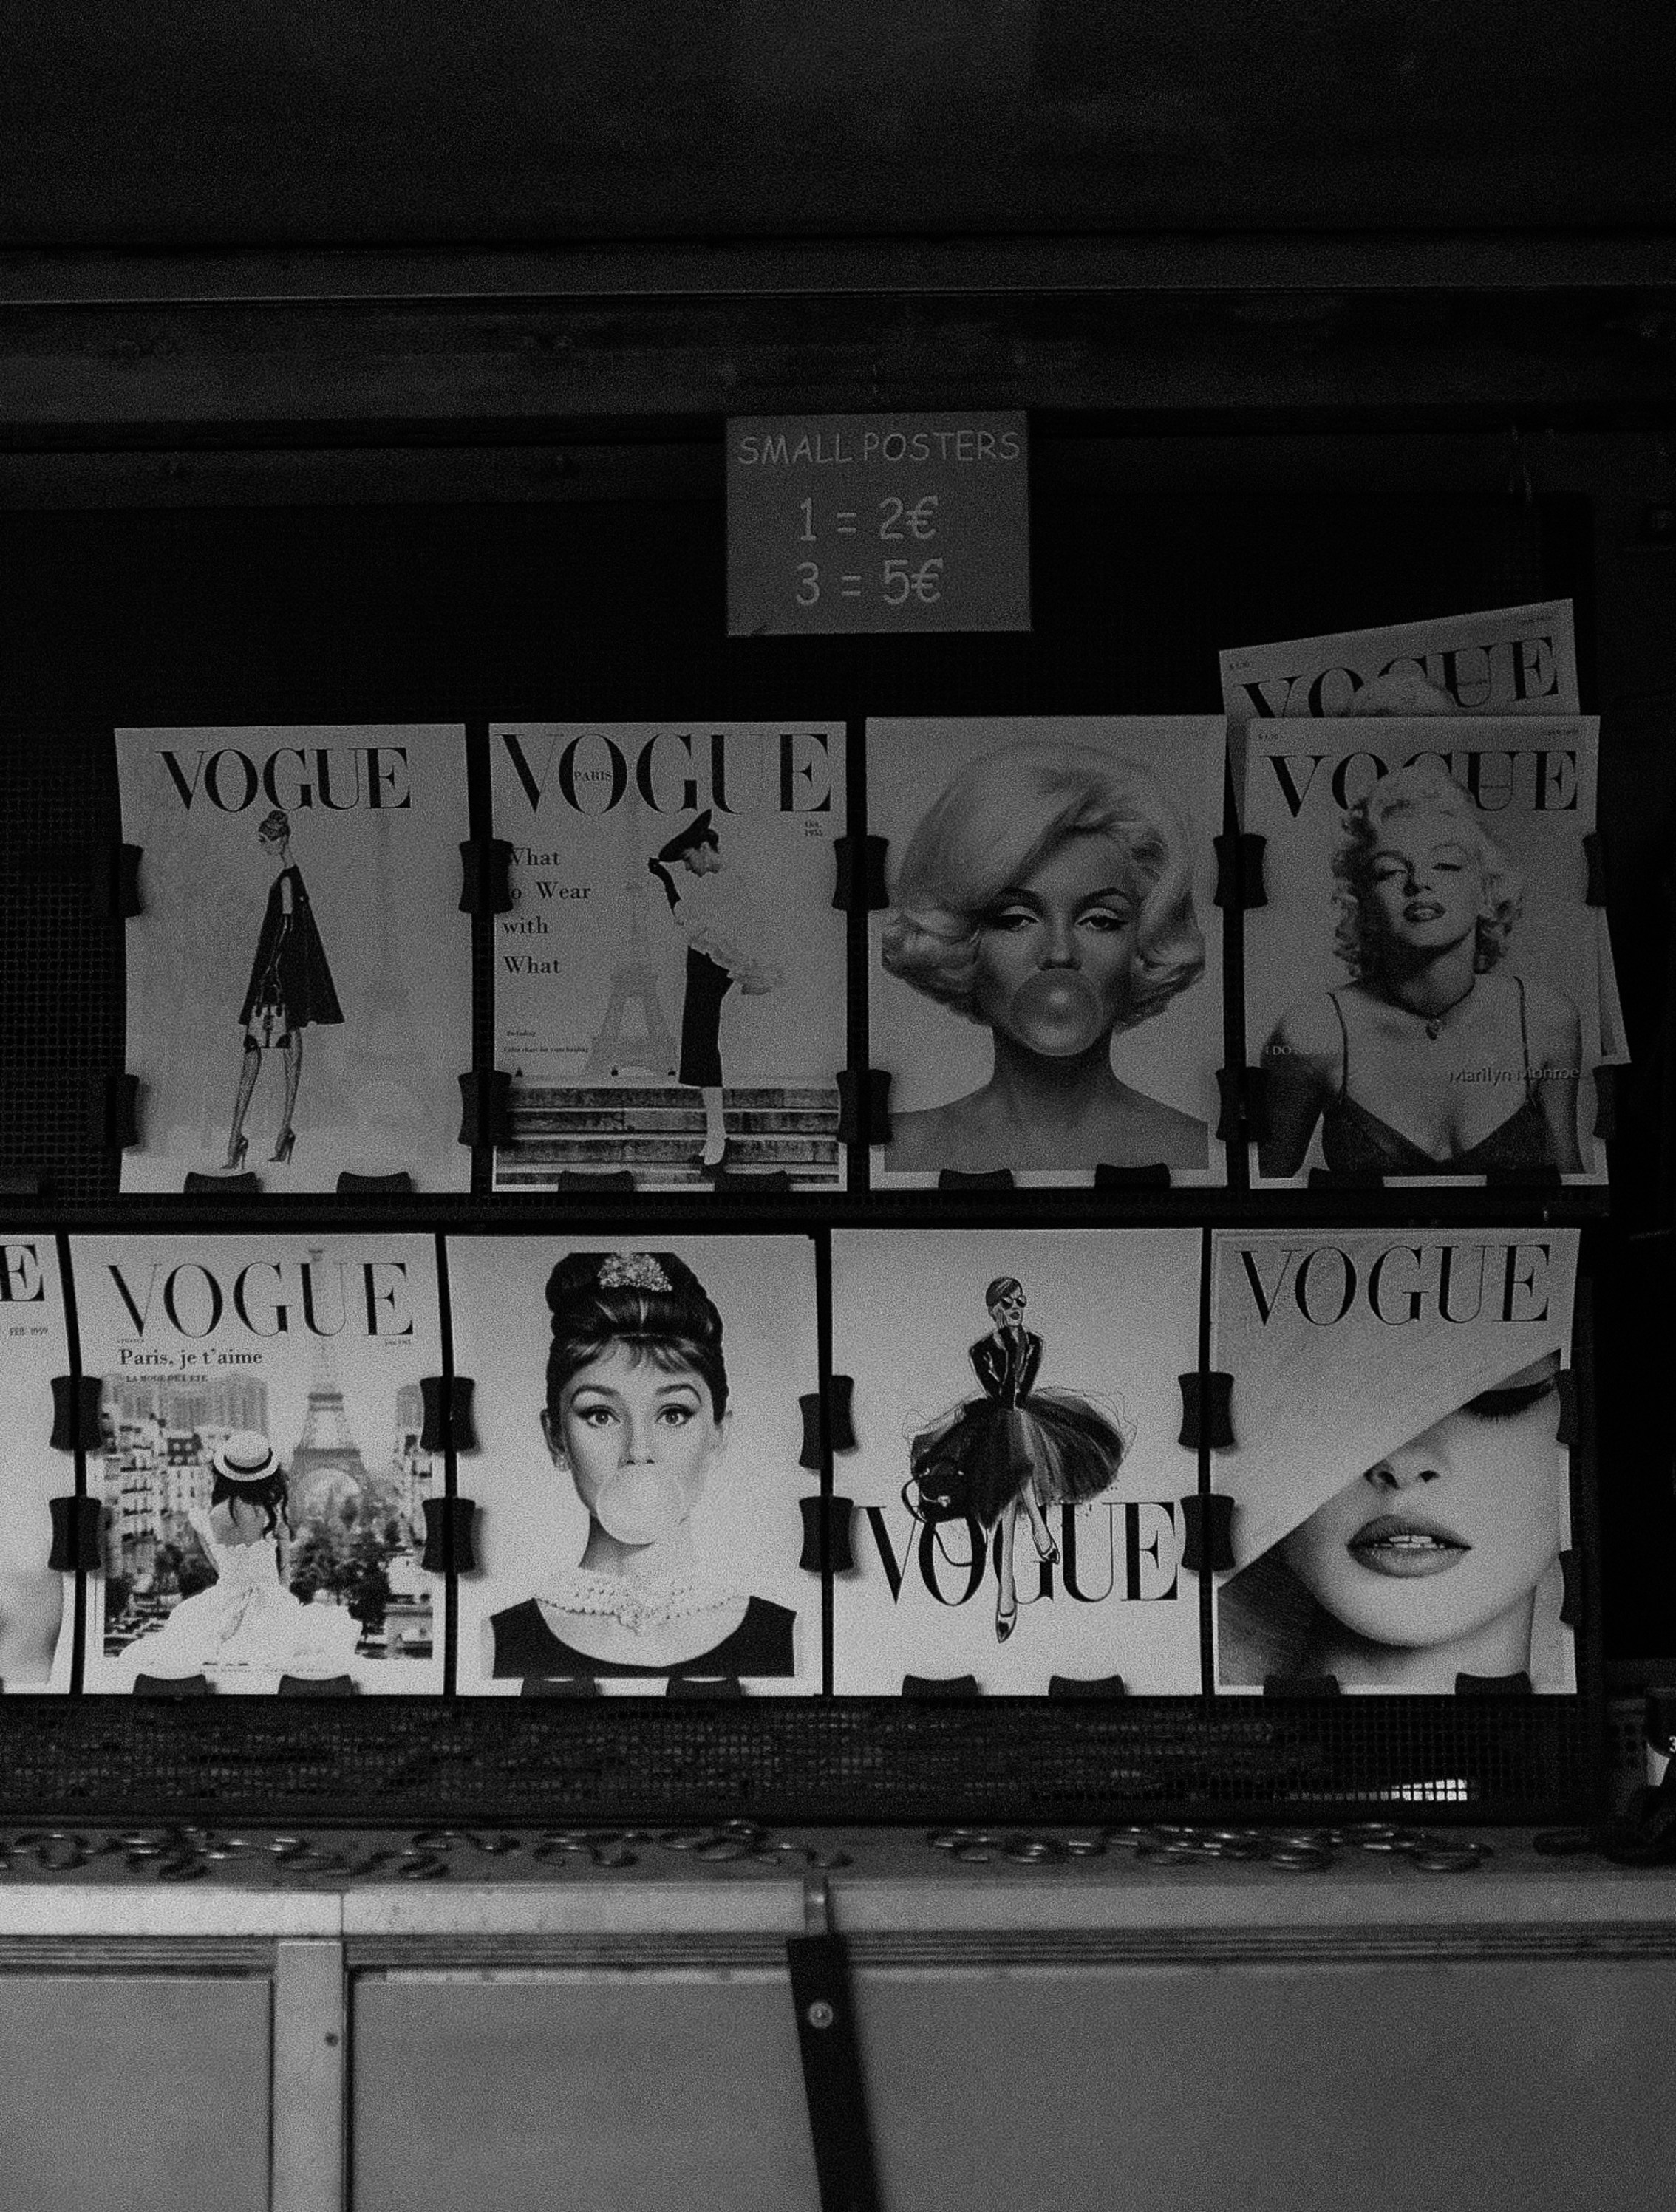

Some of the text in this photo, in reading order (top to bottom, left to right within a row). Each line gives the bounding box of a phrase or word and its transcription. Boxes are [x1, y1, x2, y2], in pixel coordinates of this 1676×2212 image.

[738, 430, 1020, 465] SMALL POSTERS
[800, 495, 939, 541] 1 = 2€
[796, 557, 944, 606] 3 = 5€
[1242, 635, 1559, 717] VOUE
[155, 747, 412, 813] VOGUE
[493, 732, 832, 814] VOGUE
[573, 771, 612, 782] PARIS
[1258, 750, 1578, 819] VOUE
[536, 881, 591, 899] Wear
[502, 915, 548, 934] with
[503, 956, 562, 974] What
[1272, 1045, 1292, 1055] DO
[1447, 1067, 1581, 1087] Marilyn Monroe
[102, 1260, 414, 1339] VOGUE
[1233, 1243, 1550, 1326] VOGUE
[179, 1349, 199, 1370] je
